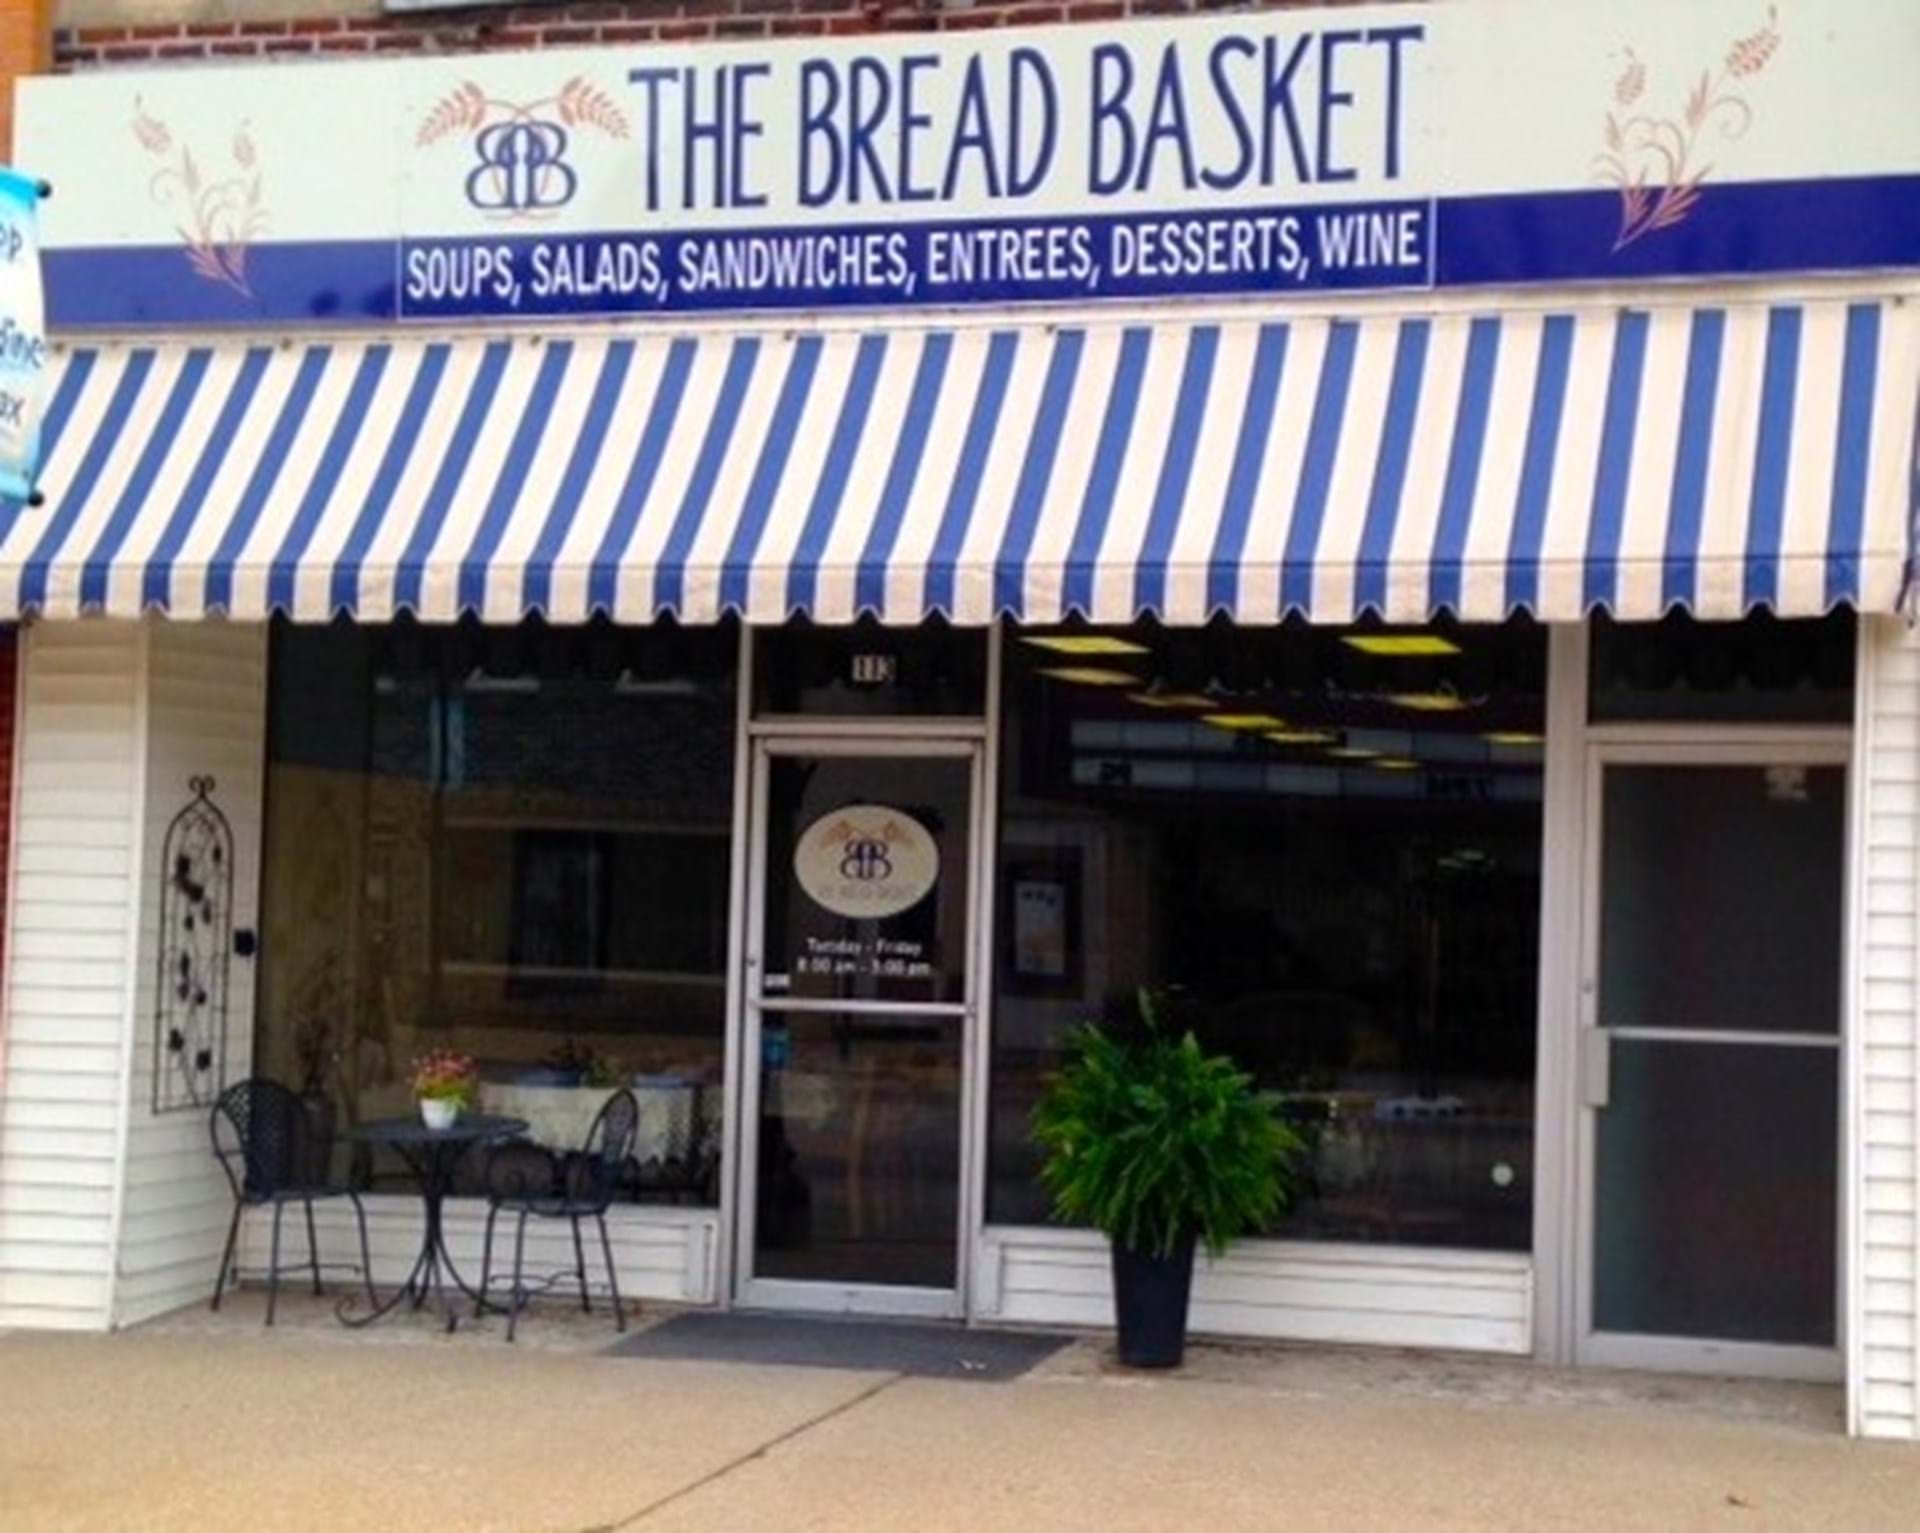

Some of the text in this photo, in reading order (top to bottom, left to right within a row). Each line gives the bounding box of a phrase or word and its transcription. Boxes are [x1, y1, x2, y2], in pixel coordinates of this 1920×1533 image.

[628, 24, 1425, 211] THE BREAD BASKET
[406, 211, 1422, 305] SOUPS, SALADS, SANDWICHES, ENTREES, DESSERTS, WINE
[806, 937, 863, 957] Tuesday
[876, 938, 922, 958] Friday
